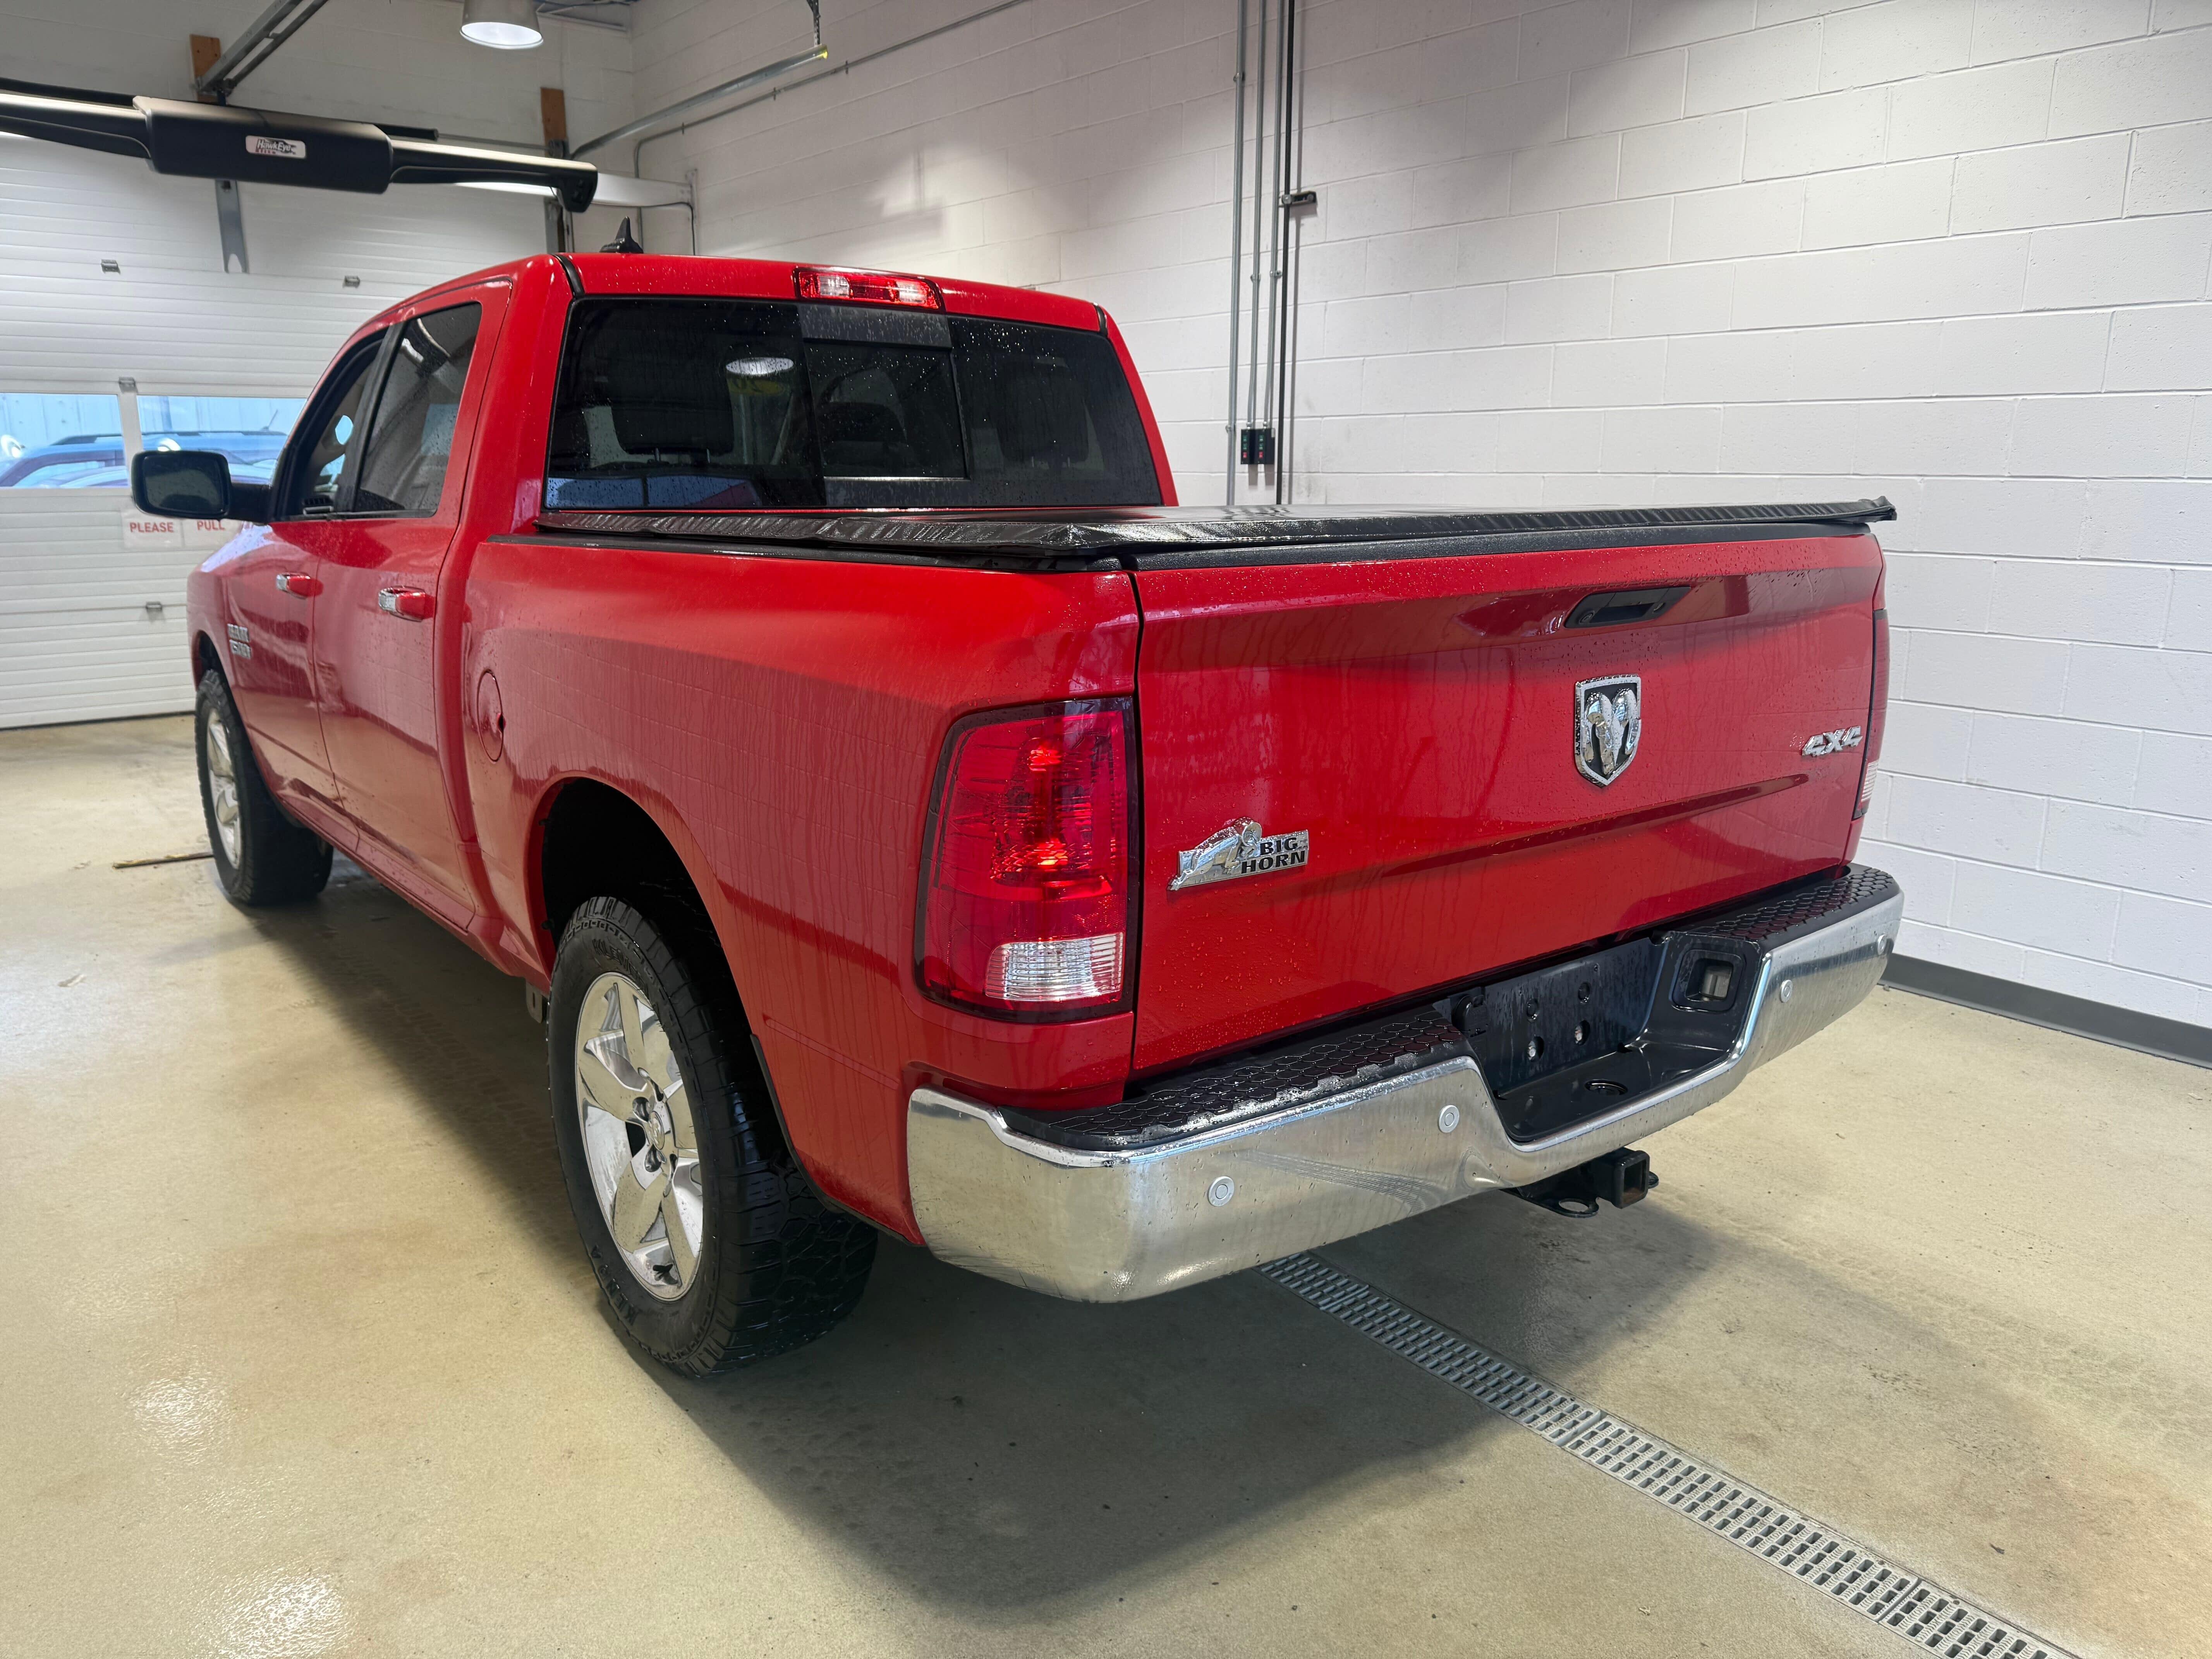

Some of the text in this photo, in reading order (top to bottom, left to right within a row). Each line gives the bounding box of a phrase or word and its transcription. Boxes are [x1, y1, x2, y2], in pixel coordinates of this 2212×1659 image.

[129, 520, 226, 533] PLEASE PULL
[1260, 837, 1298, 855] BIG
[1241, 850, 1305, 874] HORN
